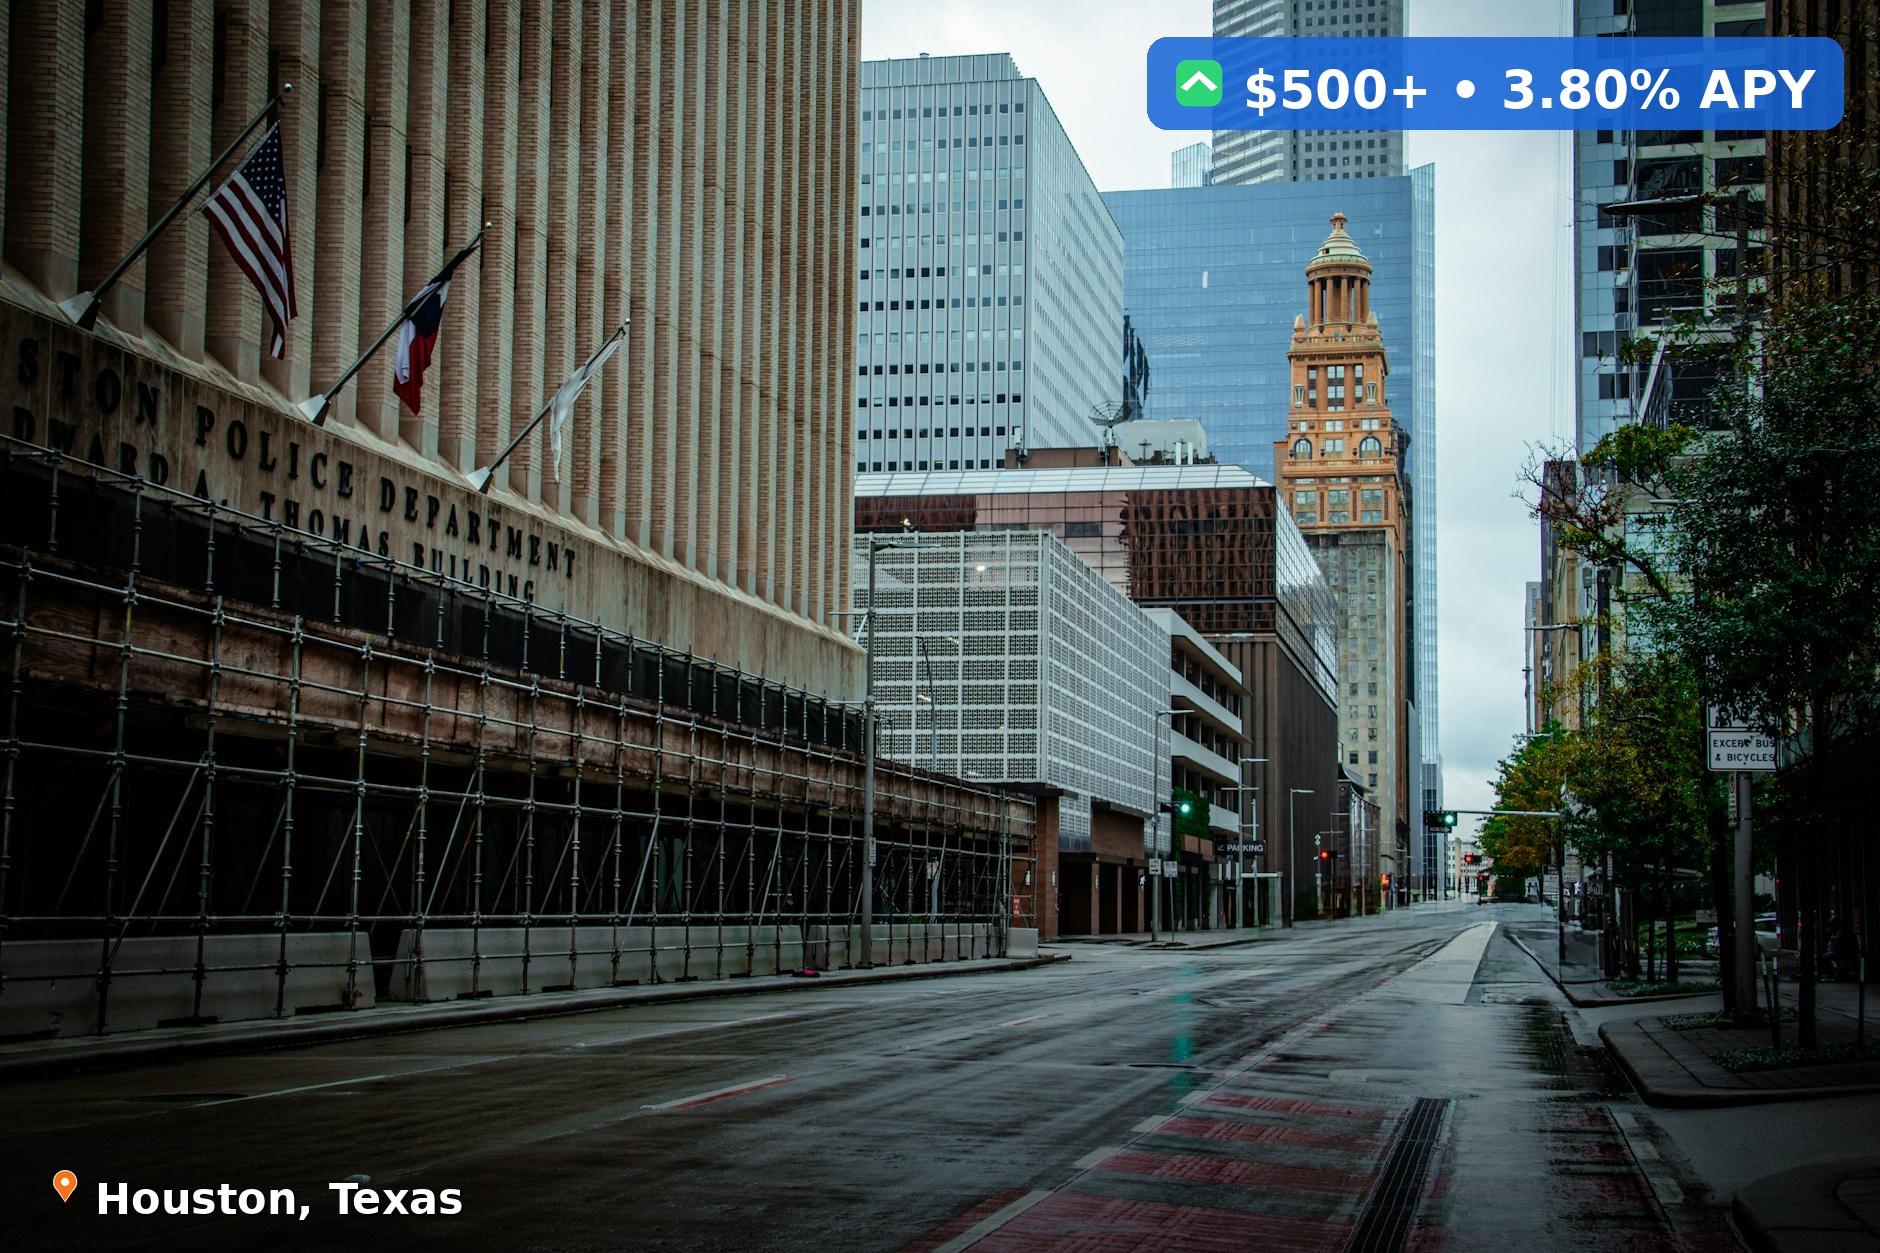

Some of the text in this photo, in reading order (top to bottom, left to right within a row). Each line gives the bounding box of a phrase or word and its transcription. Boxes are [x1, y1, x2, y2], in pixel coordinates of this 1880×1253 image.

[195, 405, 353, 498] POLICE
[380, 476, 576, 578] DEPARTMENT
[260, 491, 389, 556] THOMAS
[413, 541, 535, 603] BUILDING
[1713, 739, 1776, 749] EXCEP BUS
[1715, 753, 1775, 762] & BICYCLES
